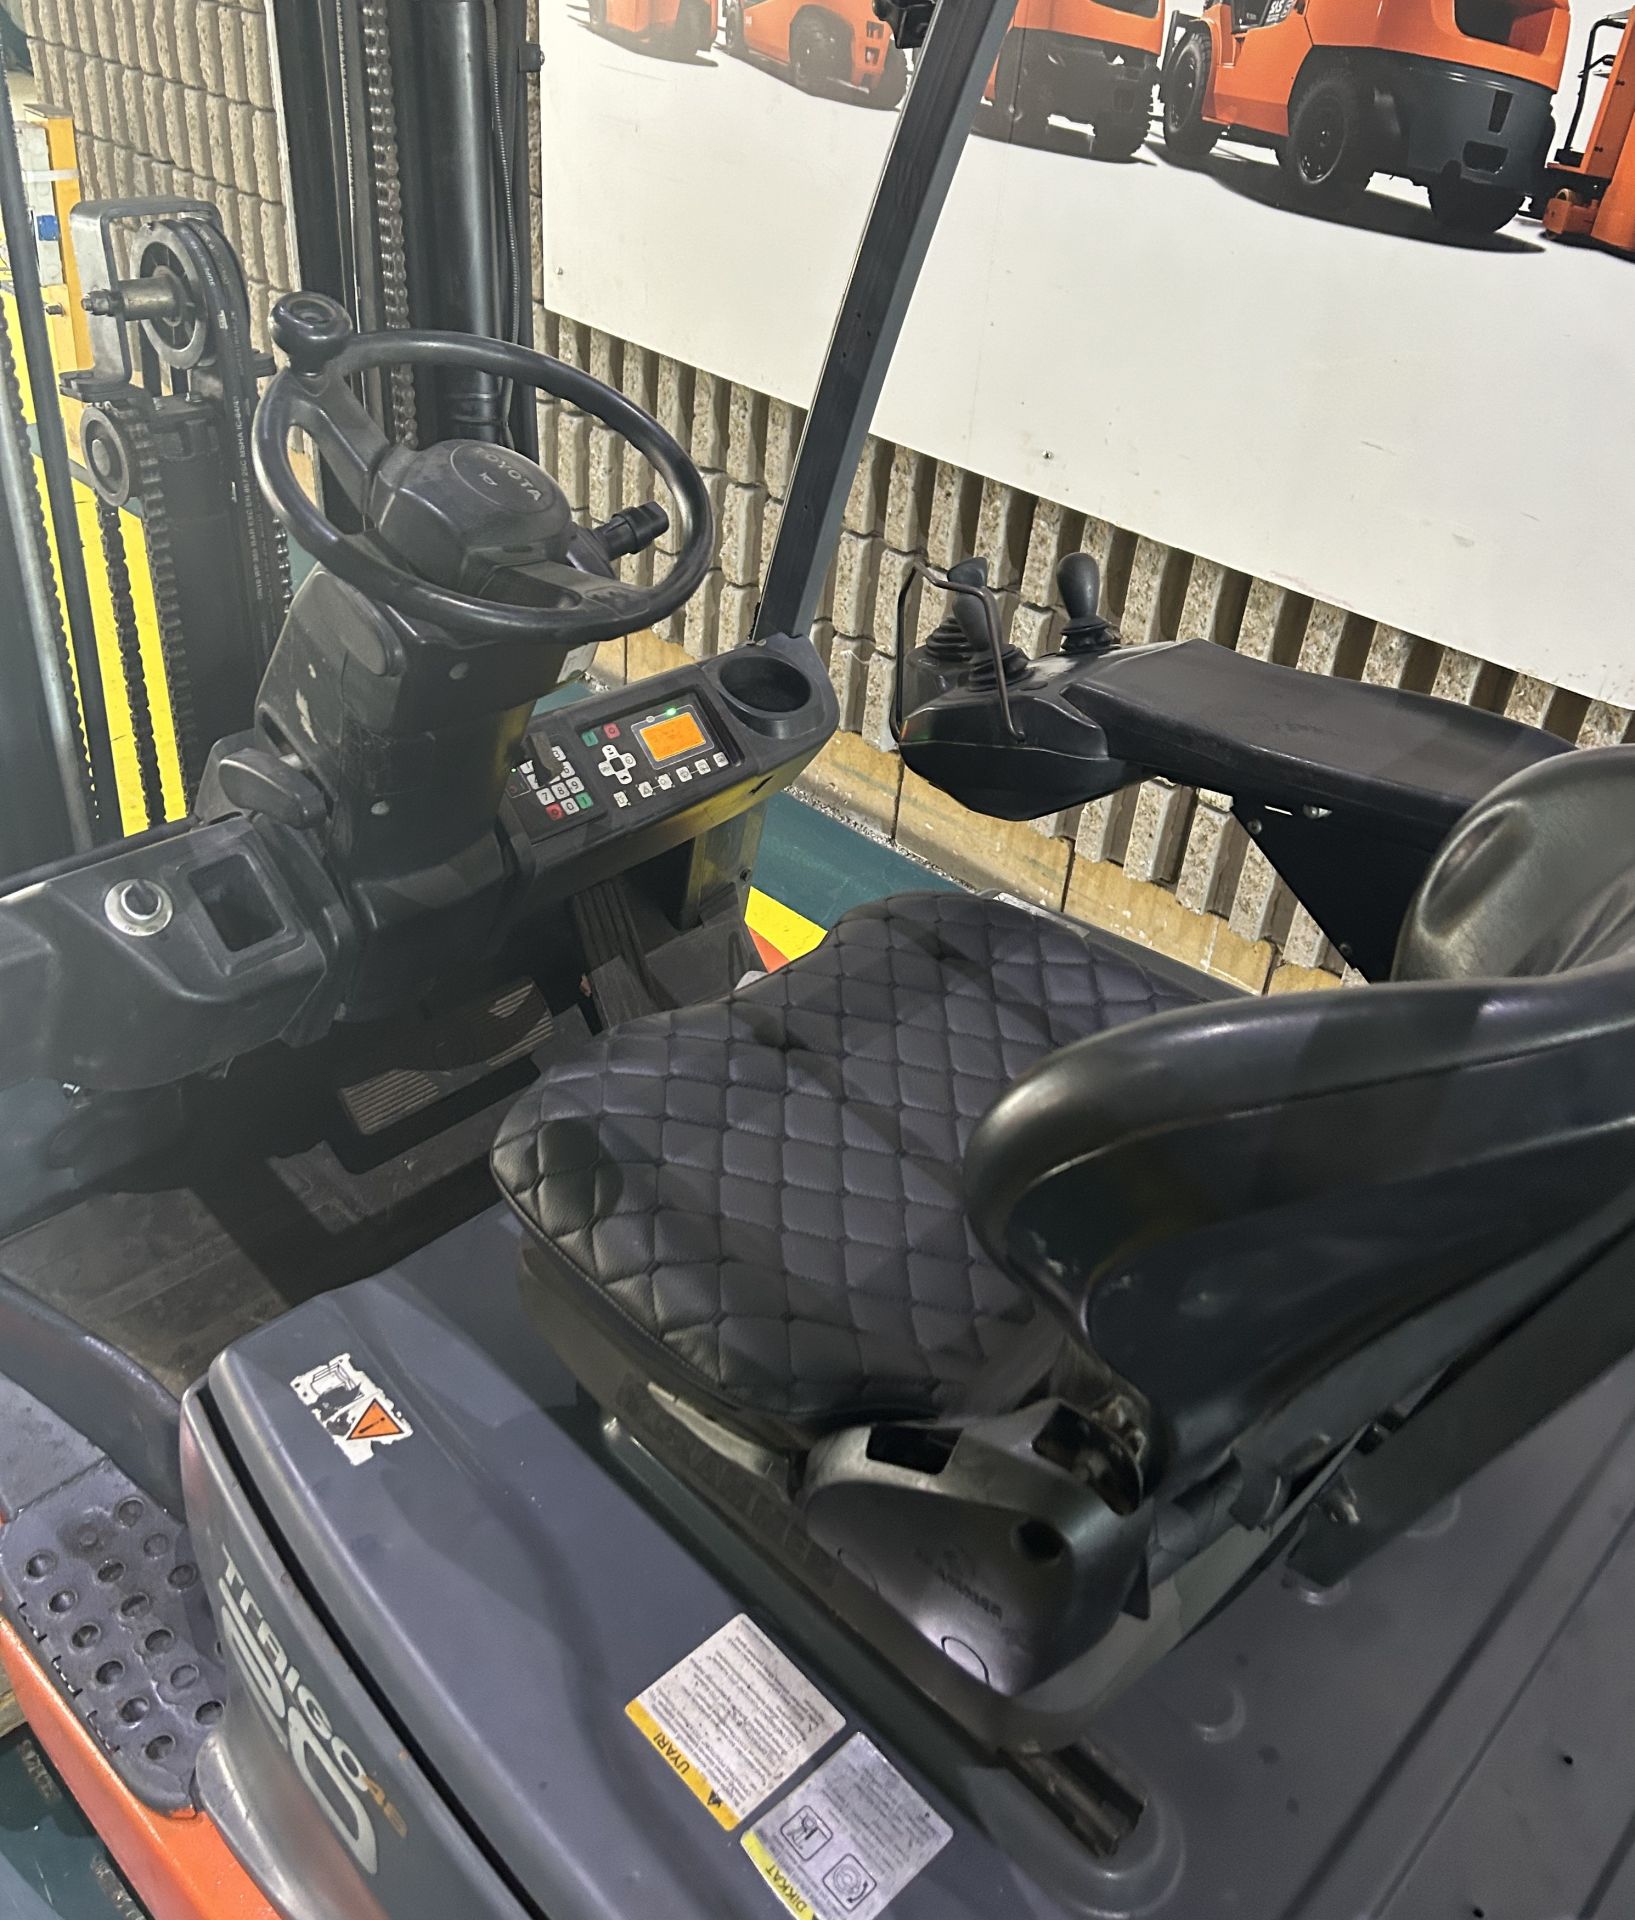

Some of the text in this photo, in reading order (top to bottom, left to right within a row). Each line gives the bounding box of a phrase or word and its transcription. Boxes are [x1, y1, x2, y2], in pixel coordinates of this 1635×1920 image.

[236, 431, 246, 458] MSHA
[472, 447, 541, 501] TOYOTA
[541, 781, 578, 801] 7 8 9
[218, 1577, 378, 1875] 20
[653, 1732, 690, 1775] UYARI
